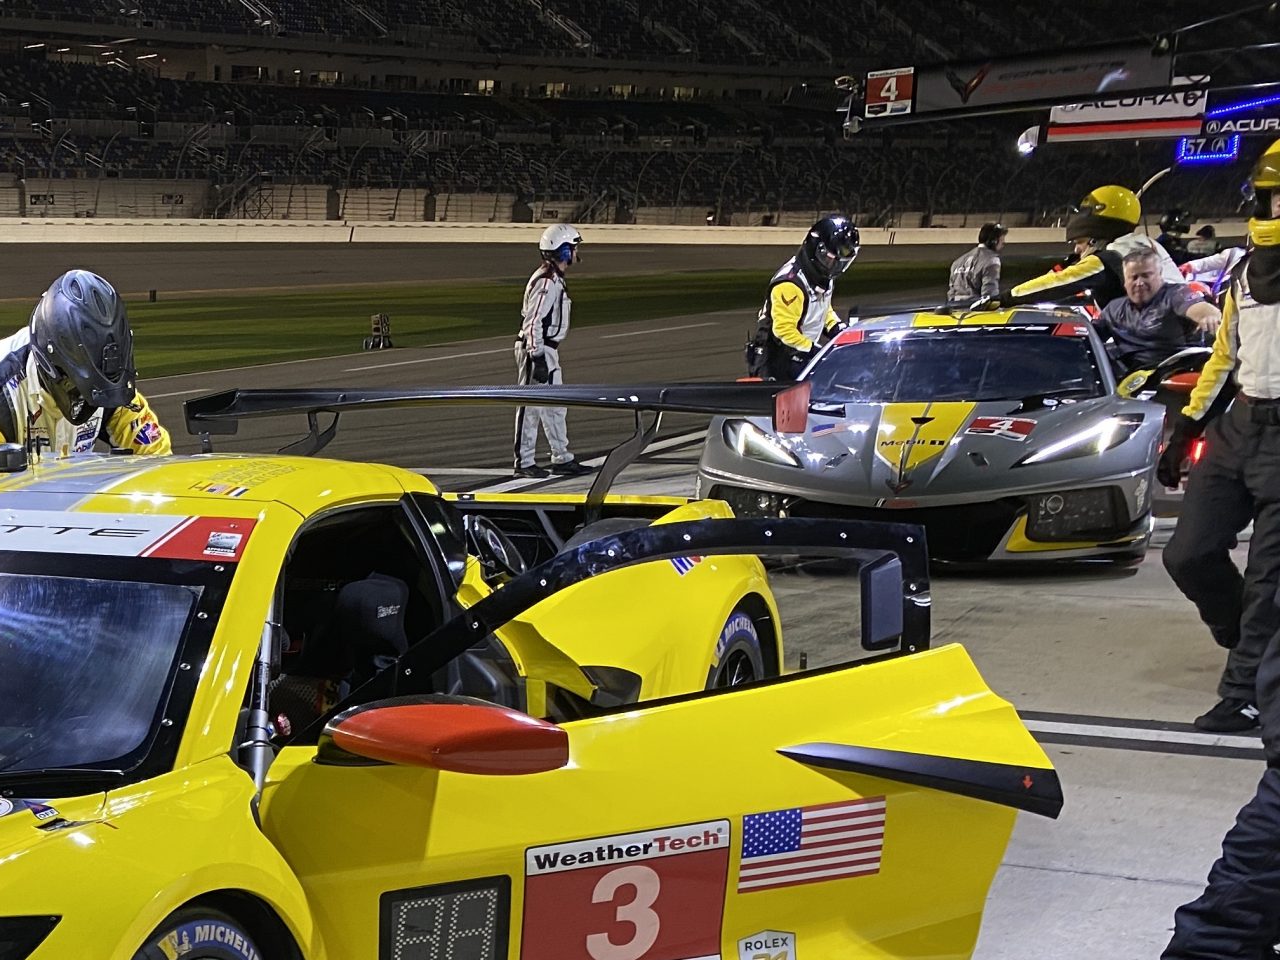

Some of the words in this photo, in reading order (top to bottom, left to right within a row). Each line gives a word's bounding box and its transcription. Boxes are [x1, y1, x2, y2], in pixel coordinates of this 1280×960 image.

[880, 77, 898, 100] 4
[1221, 118, 1280, 132] ACUR
[1185, 138, 1206, 155] 57
[989, 420, 1014, 430] 4
[725, 616, 758, 644] MICHELIN
[534, 830, 719, 870] WeatherTech
[745, 937, 788, 951] ROLEX
